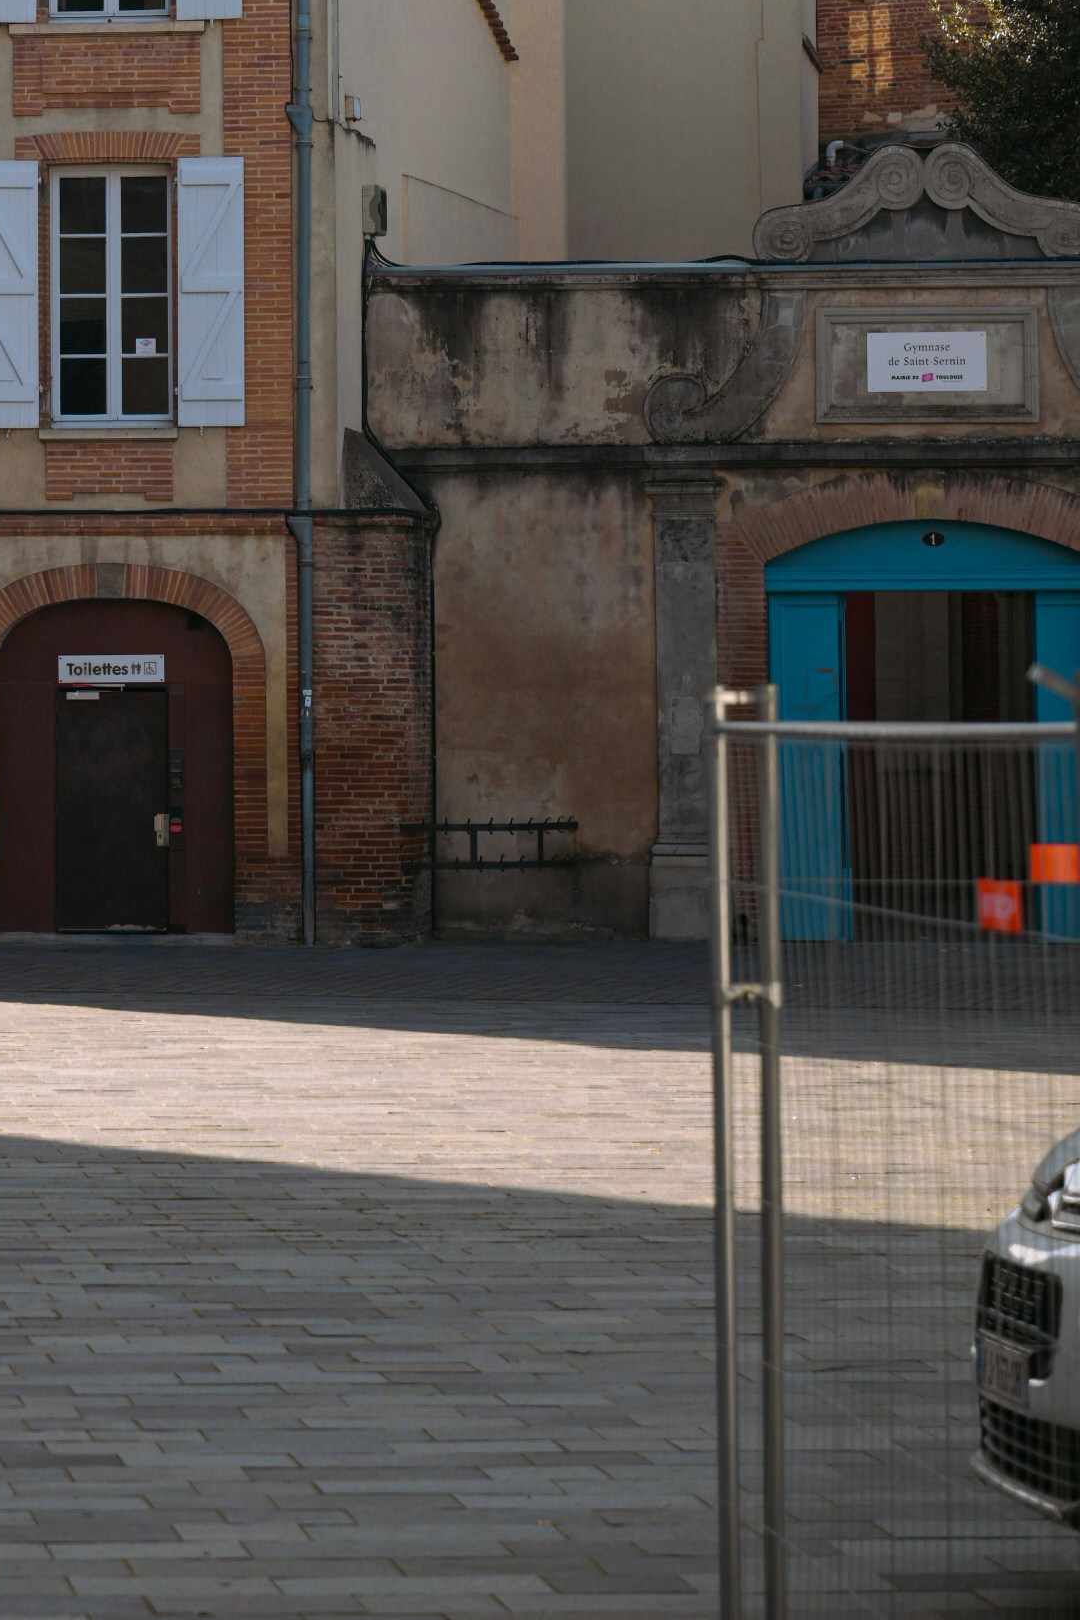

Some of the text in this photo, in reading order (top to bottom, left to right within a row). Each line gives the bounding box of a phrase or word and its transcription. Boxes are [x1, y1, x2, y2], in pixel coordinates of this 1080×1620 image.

[903, 342, 951, 354] Gymnase
[888, 356, 966, 366] de Saint-Sernin
[929, 533, 936, 546] 1
[66, 661, 129, 677] Toilettes
